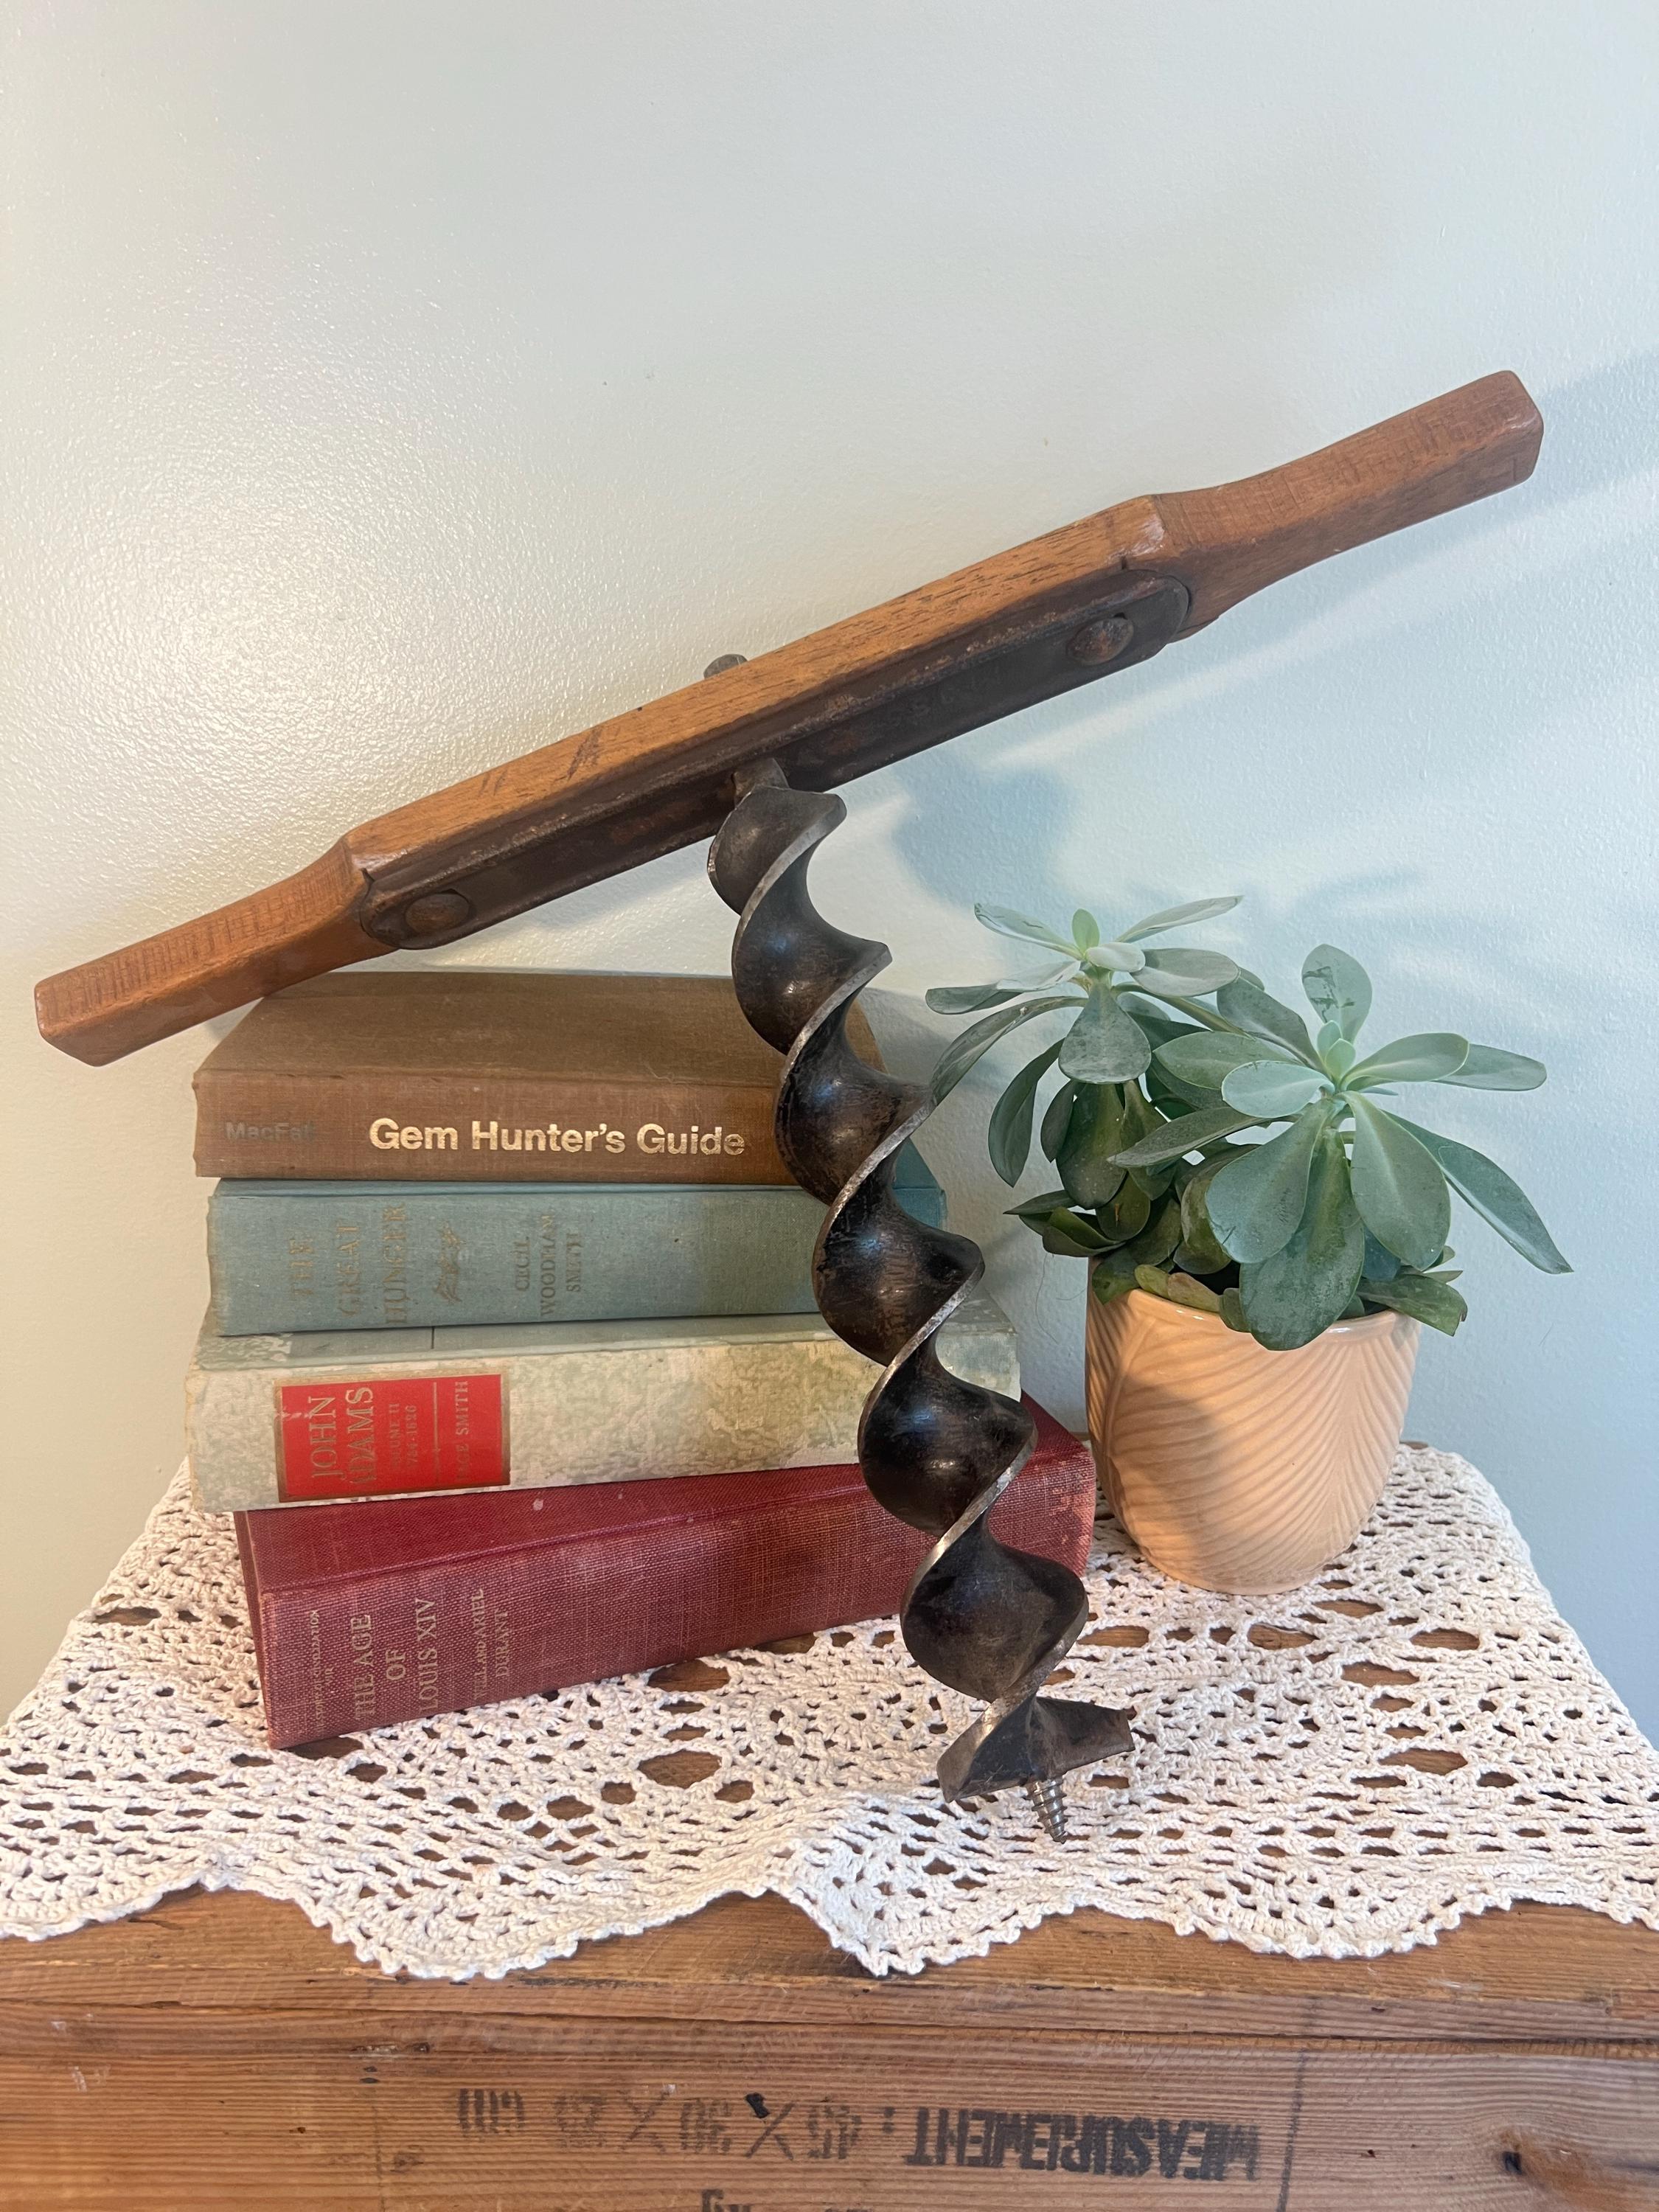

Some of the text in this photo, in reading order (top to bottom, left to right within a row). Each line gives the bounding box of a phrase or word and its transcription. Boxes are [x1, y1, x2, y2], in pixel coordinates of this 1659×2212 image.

[369, 1118, 745, 1155] Gem Hunter's Guide
[289, 1237, 313, 1296] THE
[335, 1219, 361, 1317] GREAT
[382, 1203, 410, 1324] HUNGER
[515, 1236, 530, 1292] CECIL
[566, 1231, 583, 1293] SMITH
[307, 1396, 346, 1480] JOHN
[345, 1386, 377, 1484] ADAMS
[454, 1380, 469, 1436] SMITH
[350, 1614, 375, 1720] THE AGE
[386, 1649, 406, 1681] OF
[415, 1597, 439, 1712] LOUIS XIV
[495, 1607, 510, 1678] DURANT
